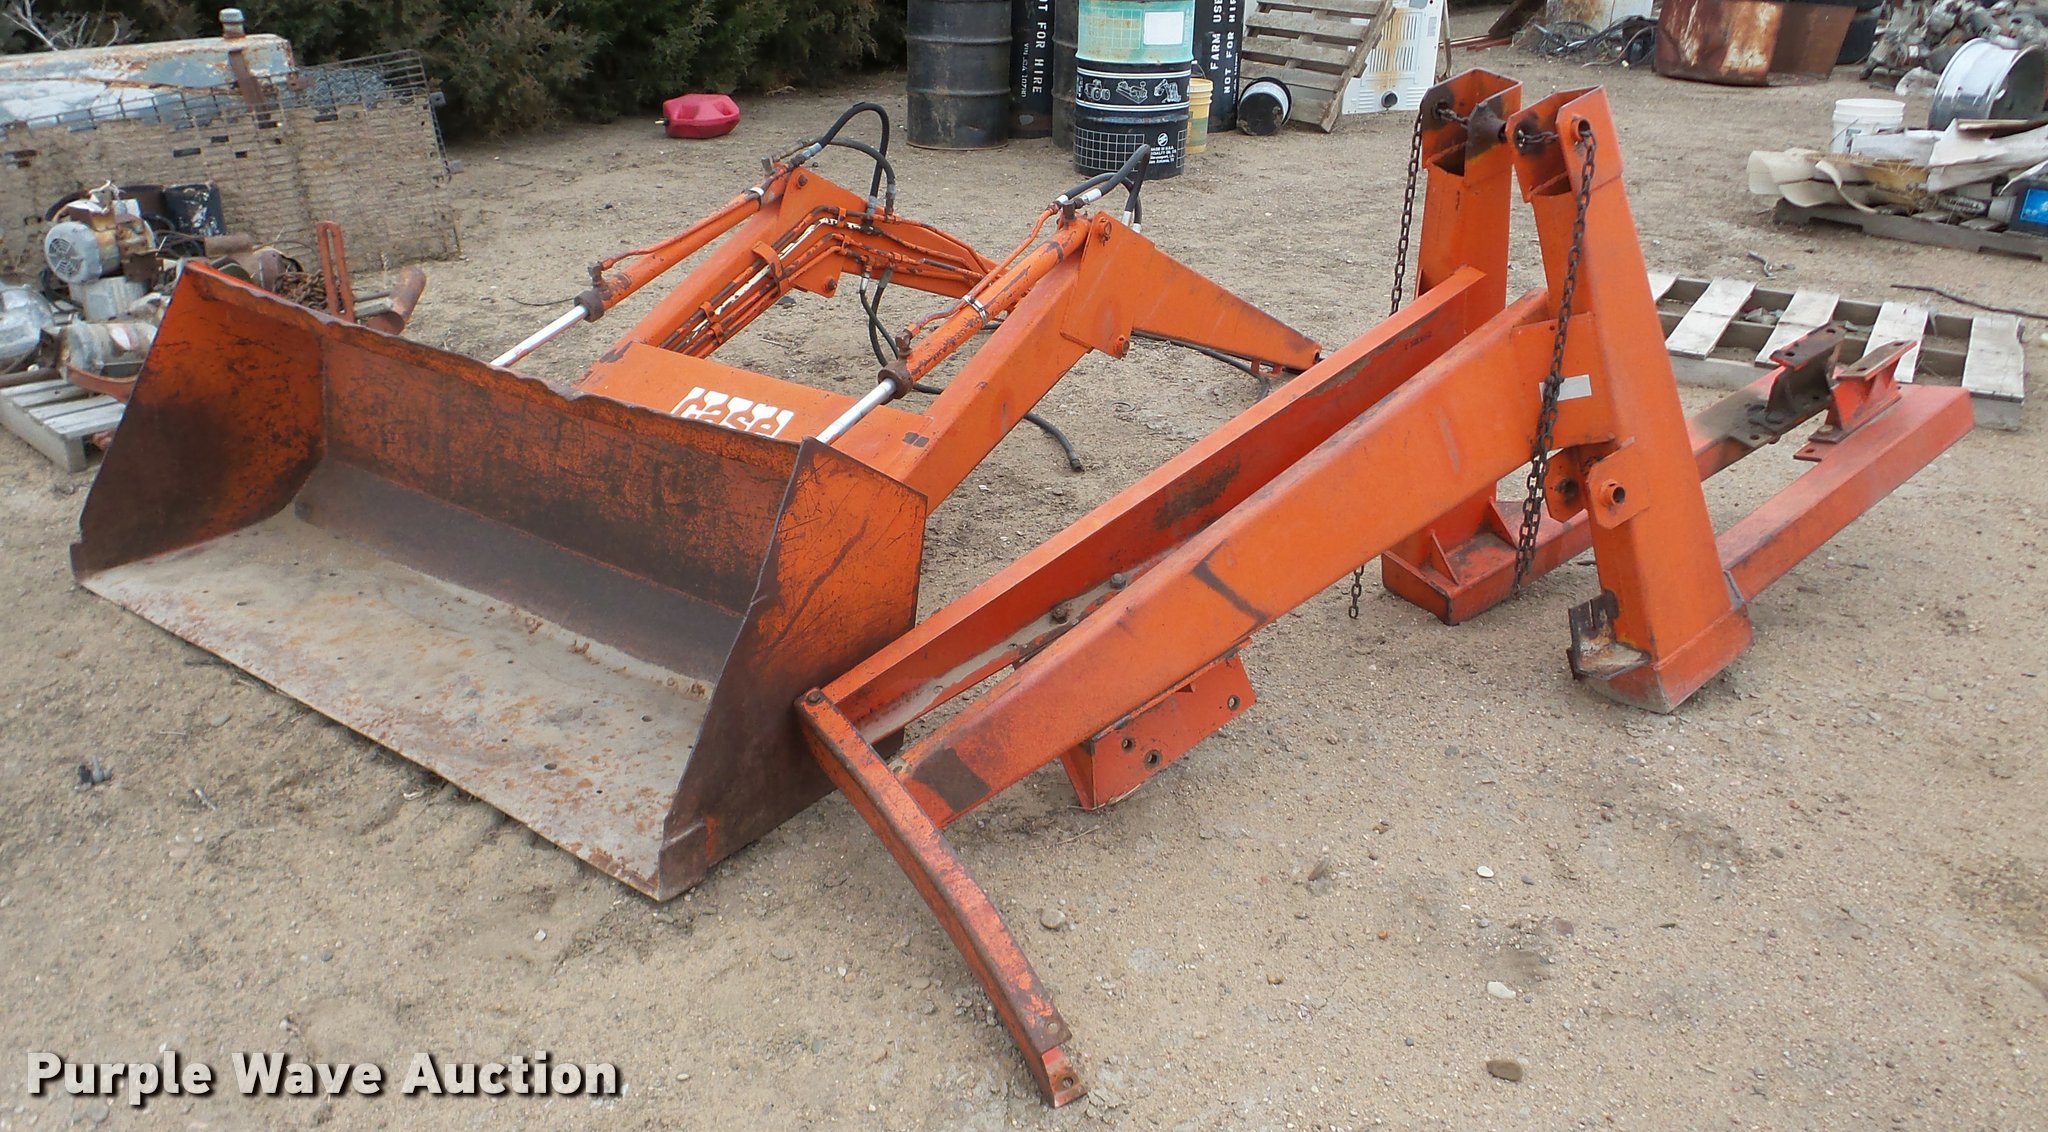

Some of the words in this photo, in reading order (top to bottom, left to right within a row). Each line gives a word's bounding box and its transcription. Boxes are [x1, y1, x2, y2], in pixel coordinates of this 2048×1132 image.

[1035, 22, 1047, 49] FOR
[1225, 31, 1234, 59] FOR
[1210, 33, 1221, 70] FARM
[1032, 58, 1044, 94] HIRE
[1223, 68, 1232, 94] NOT
